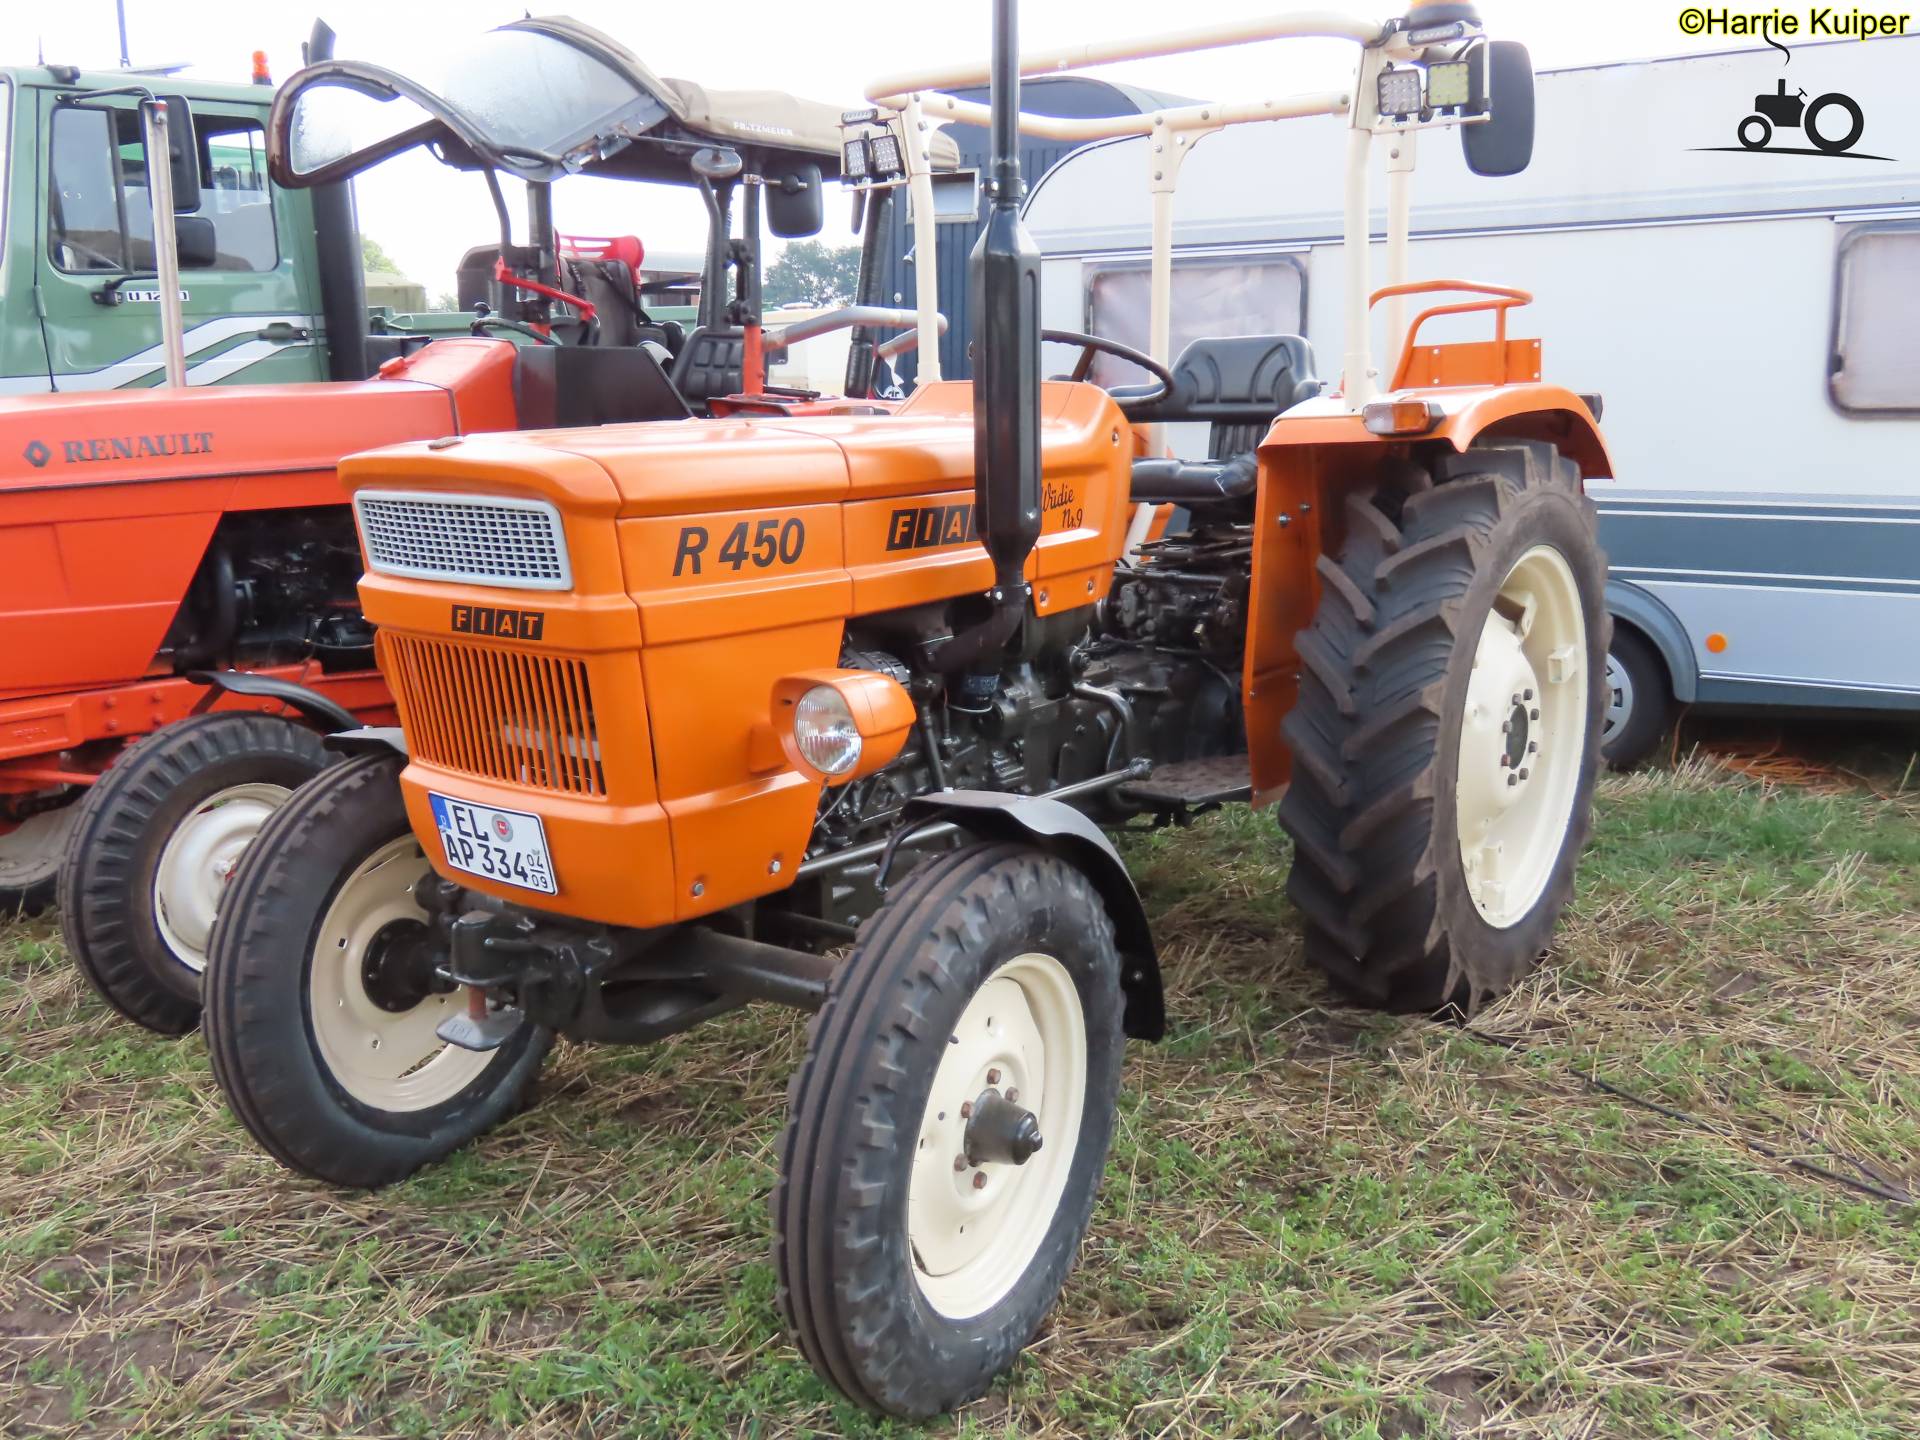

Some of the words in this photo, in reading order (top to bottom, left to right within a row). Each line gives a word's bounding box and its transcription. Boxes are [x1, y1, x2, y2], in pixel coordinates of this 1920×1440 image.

[128, 292, 140, 301] U
[62, 432, 214, 463] RENAULT
[889, 507, 966, 548] FIA
[672, 526, 709, 577] R
[718, 517, 805, 571] 450
[455, 608, 541, 638] FIAT
[451, 804, 489, 842] EL
[445, 833, 475, 867] AP
[477, 842, 529, 882] 334
[526, 853, 545, 870] 04
[531, 873, 549, 889] 09
